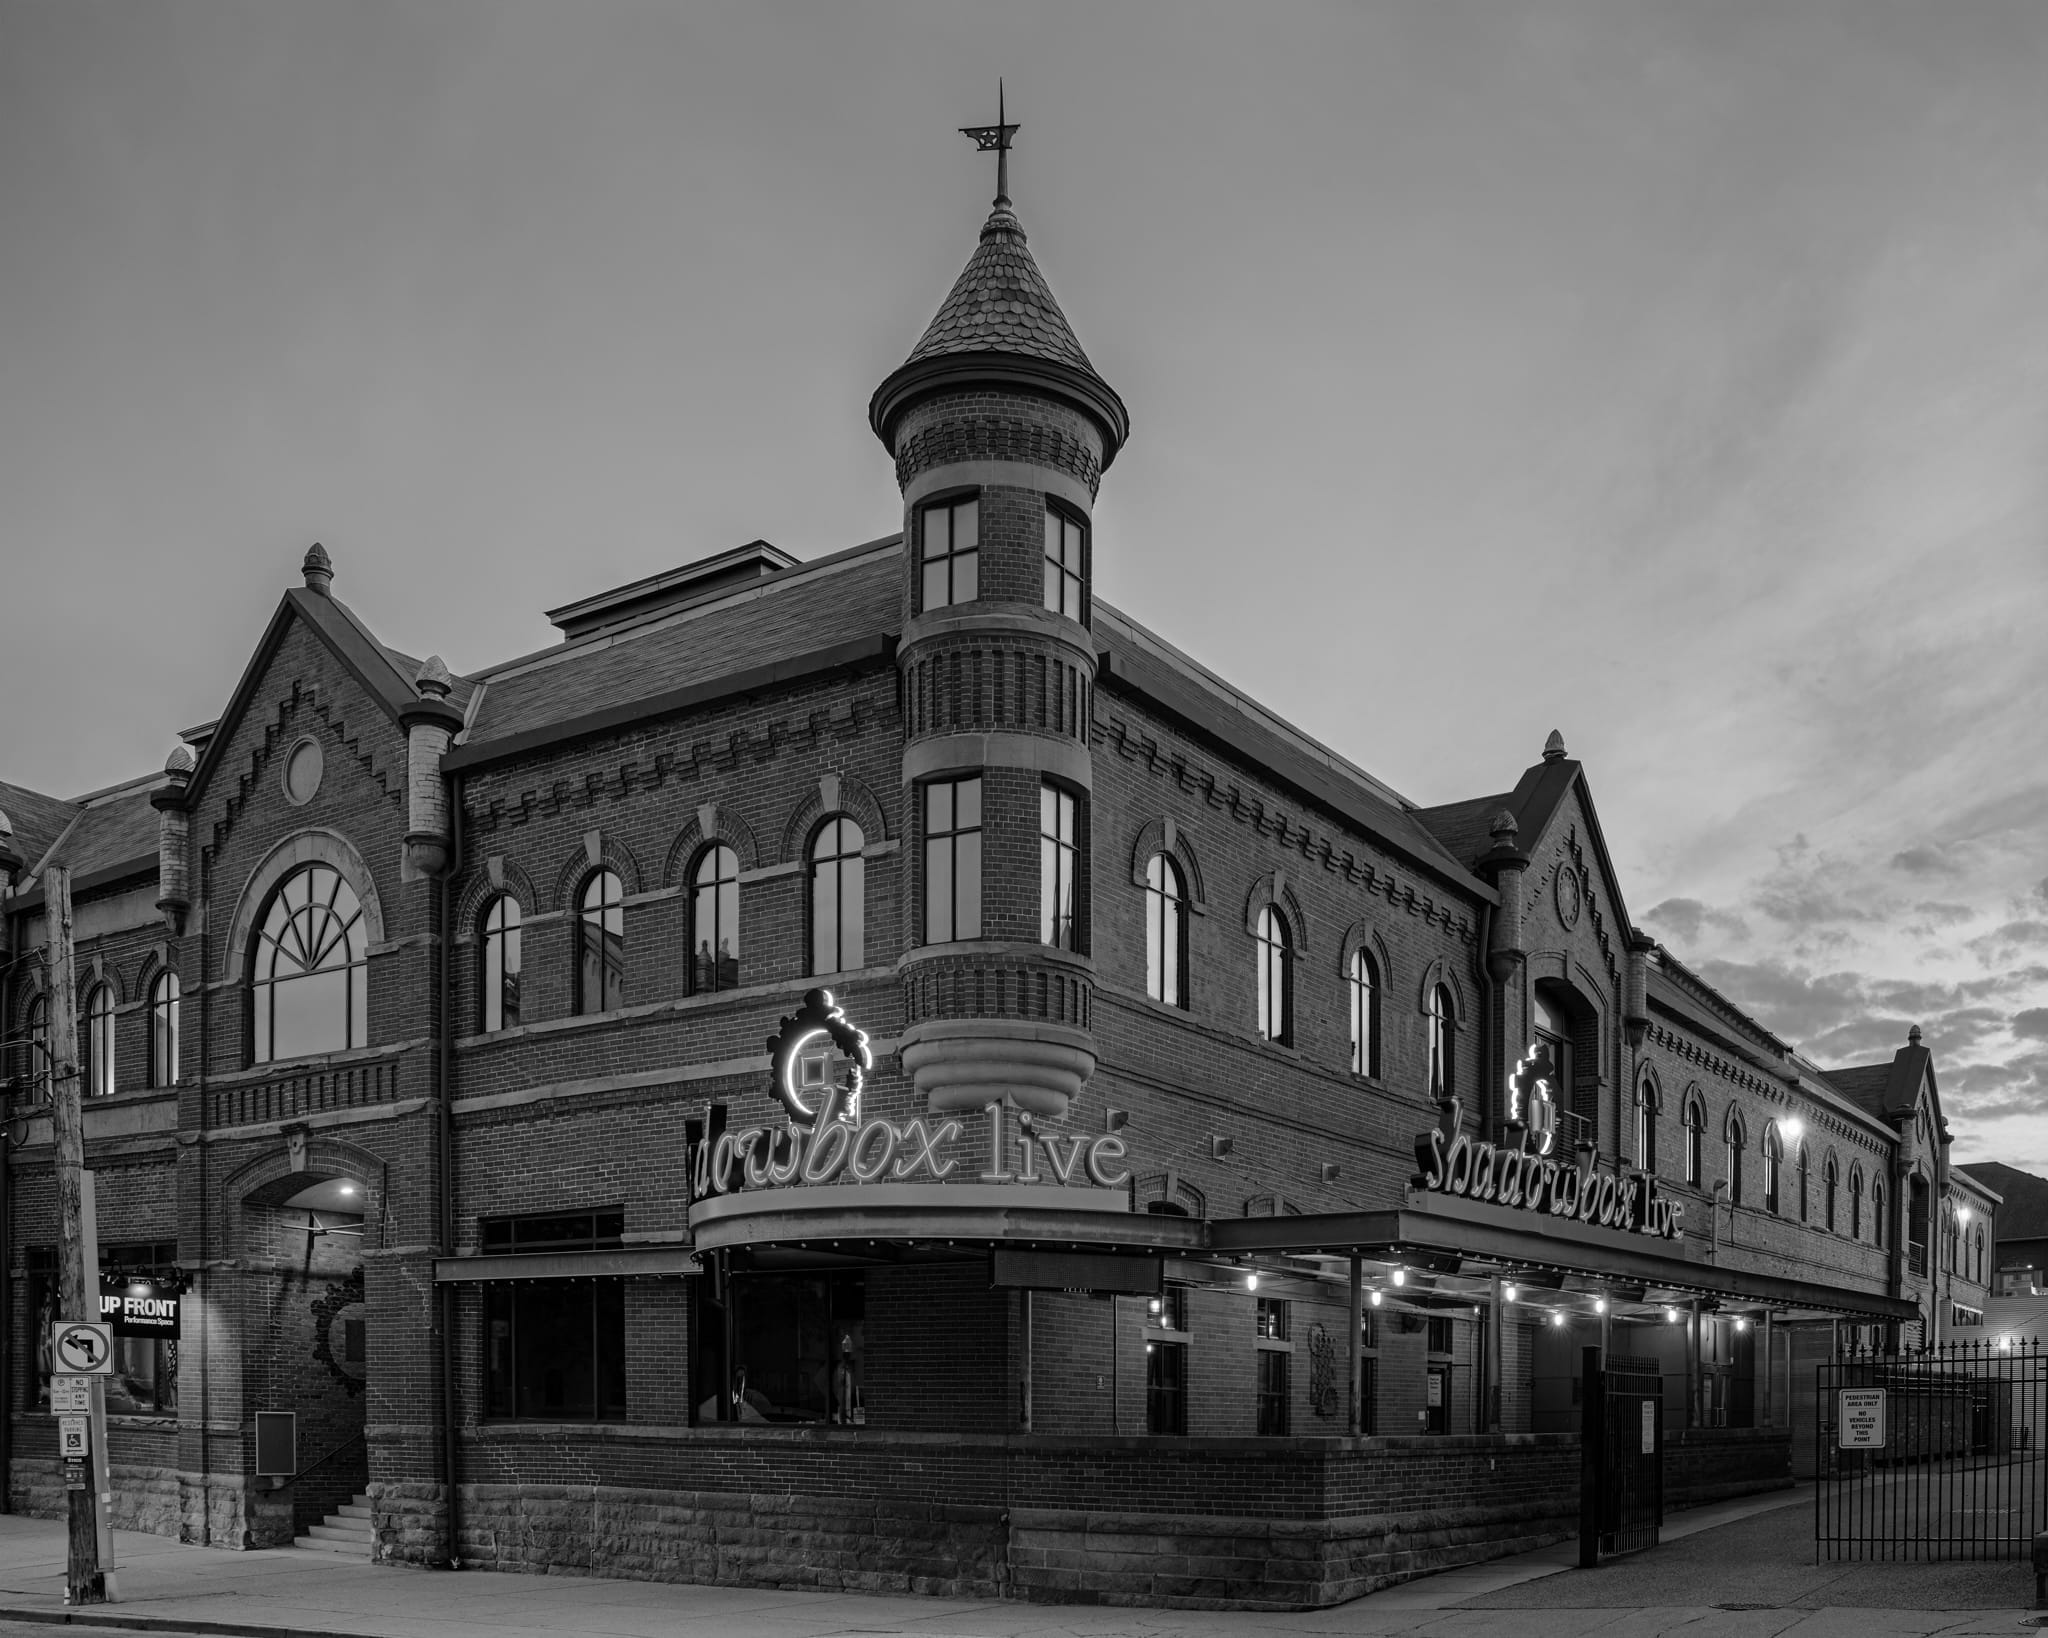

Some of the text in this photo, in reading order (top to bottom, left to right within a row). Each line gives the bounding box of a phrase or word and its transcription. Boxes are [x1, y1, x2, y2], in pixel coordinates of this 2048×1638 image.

[981, 1102, 1130, 1187] live
[1413, 1096, 1638, 1230] shadowbox
[99, 1295, 177, 1317] UP FRONT
[157, 1317, 174, 1327] Space
